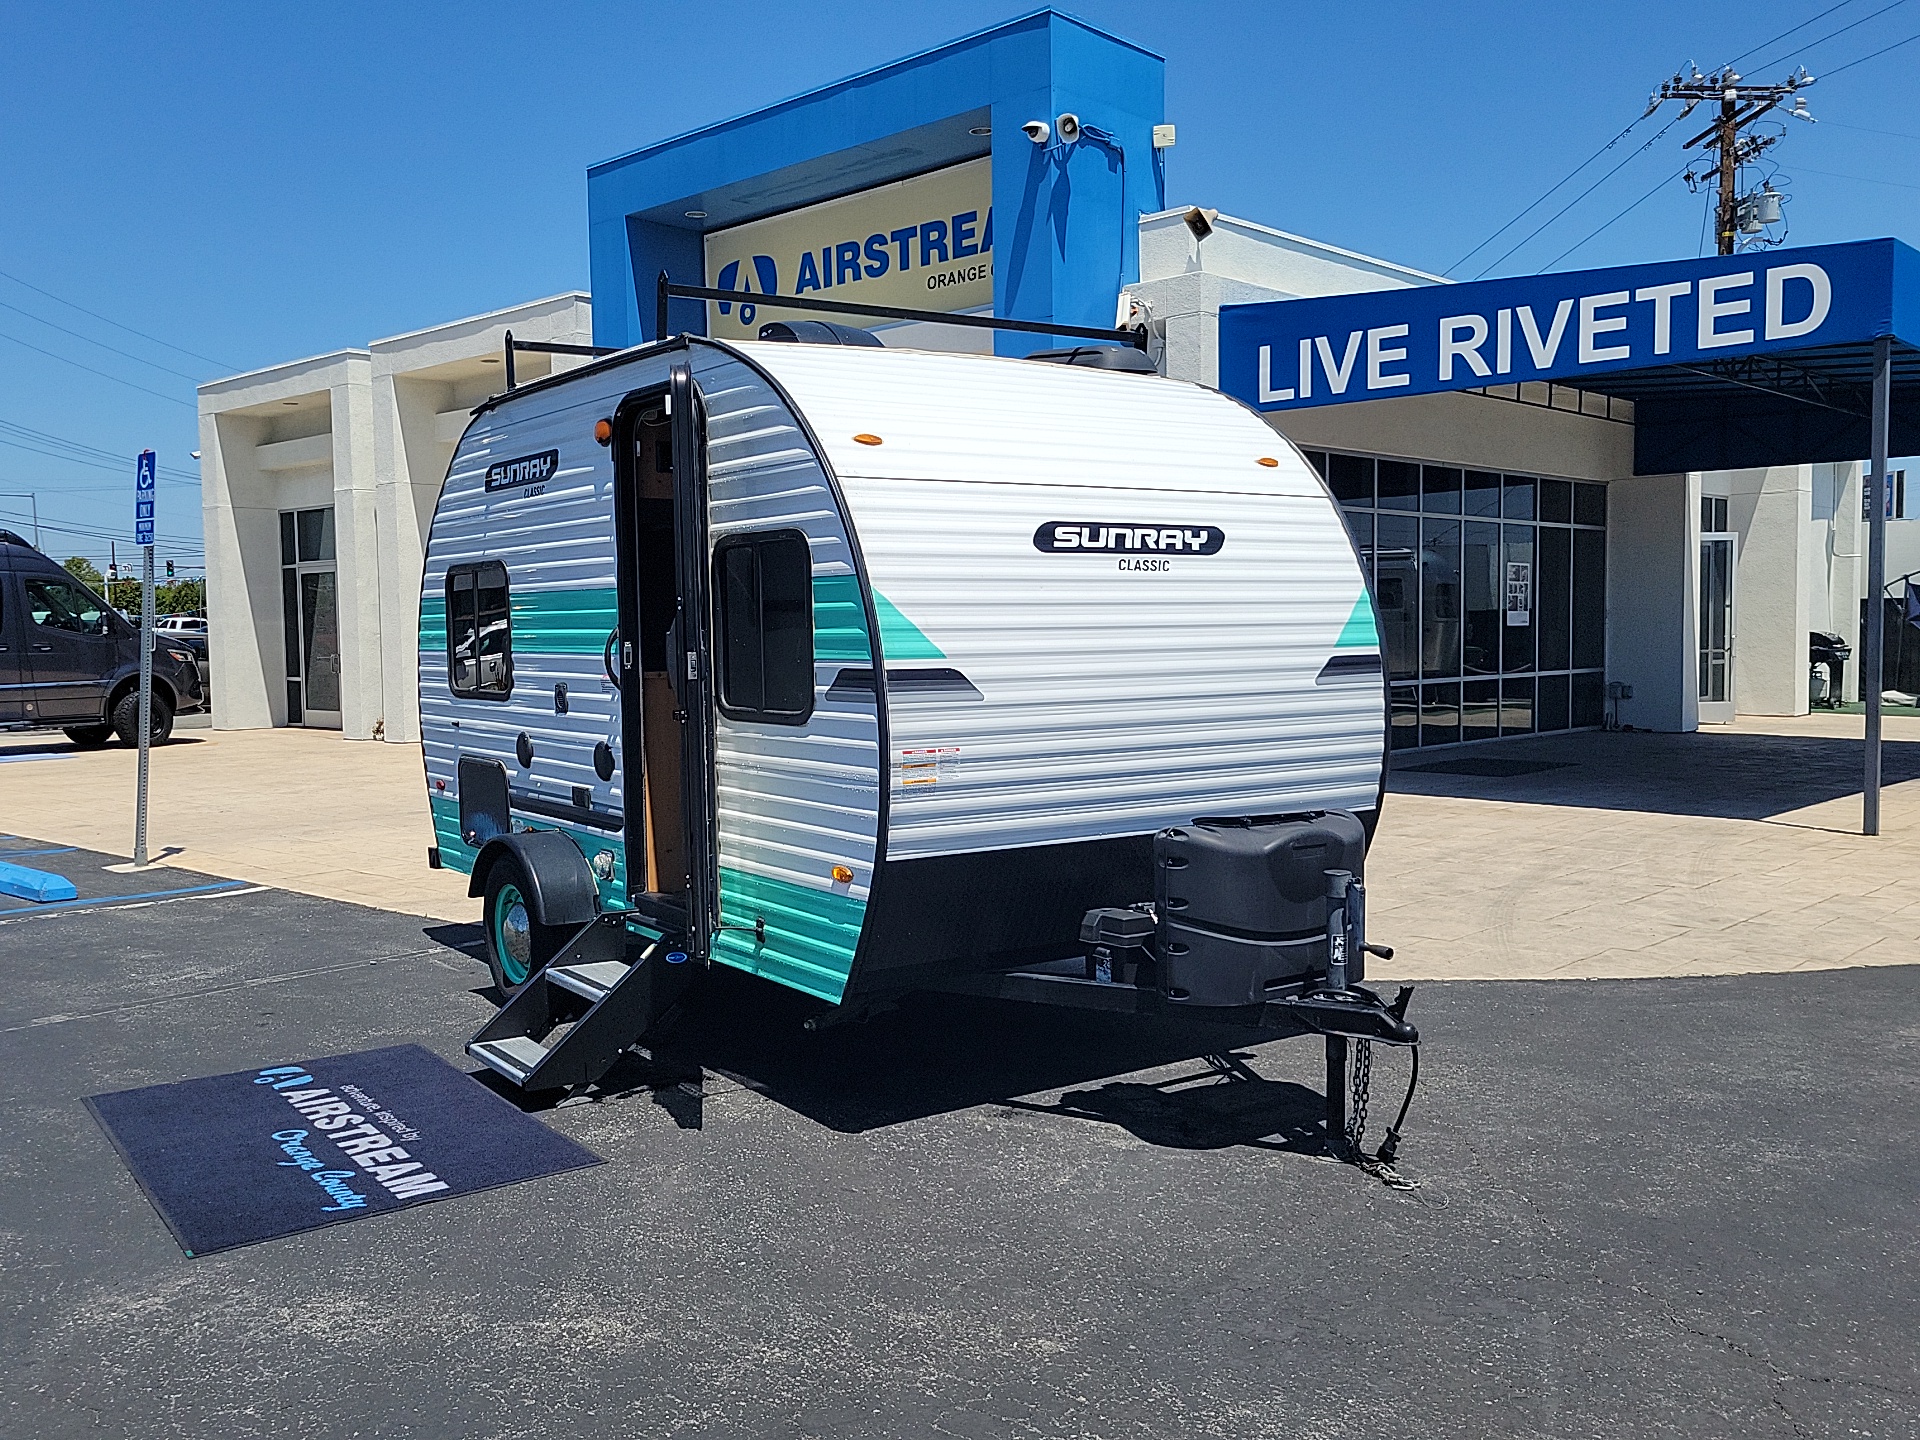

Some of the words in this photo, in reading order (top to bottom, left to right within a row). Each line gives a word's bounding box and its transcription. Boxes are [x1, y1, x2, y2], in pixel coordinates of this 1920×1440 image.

[926, 264, 987, 290] ORANGE
[1258, 323, 1410, 403] LIVE
[1438, 262, 1832, 382] RIVETED
[490, 455, 552, 487] SUNRAY
[523, 484, 546, 499] CLASSIC
[1052, 525, 1209, 551] SUNRAY
[1117, 558, 1171, 572] CLASSIC
[279, 1088, 450, 1200] AIRSTREAM
[399, 1130, 422, 1142] by
[271, 1129, 325, 1171] Orange
[311, 1170, 368, 1212] County
